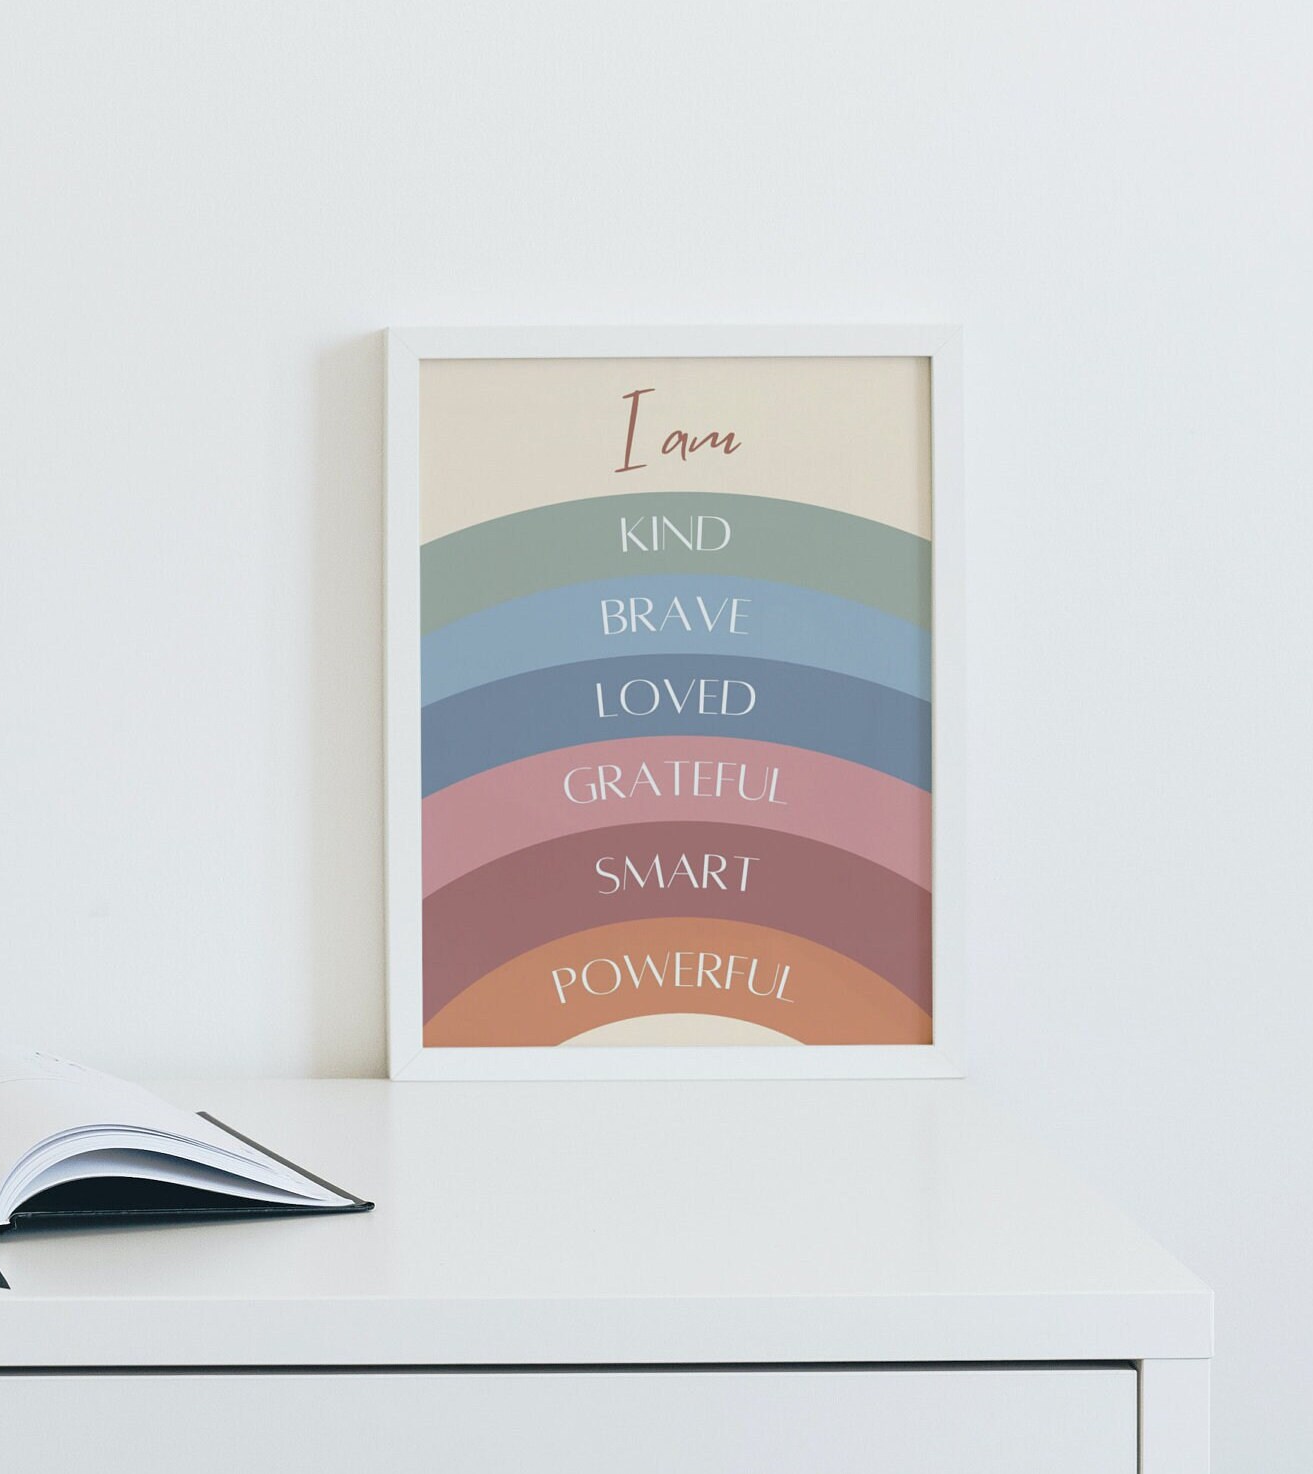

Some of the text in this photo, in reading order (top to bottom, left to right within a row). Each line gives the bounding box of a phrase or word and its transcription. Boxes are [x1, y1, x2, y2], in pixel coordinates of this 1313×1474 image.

[614, 388, 742, 473] I am
[621, 516, 731, 552] KIND
[600, 596, 752, 635] BRAVE
[595, 679, 756, 718] LOVED
[563, 761, 787, 805] GRATEFUL
[595, 853, 761, 895] SMART
[551, 952, 795, 1004] POWERFUL
